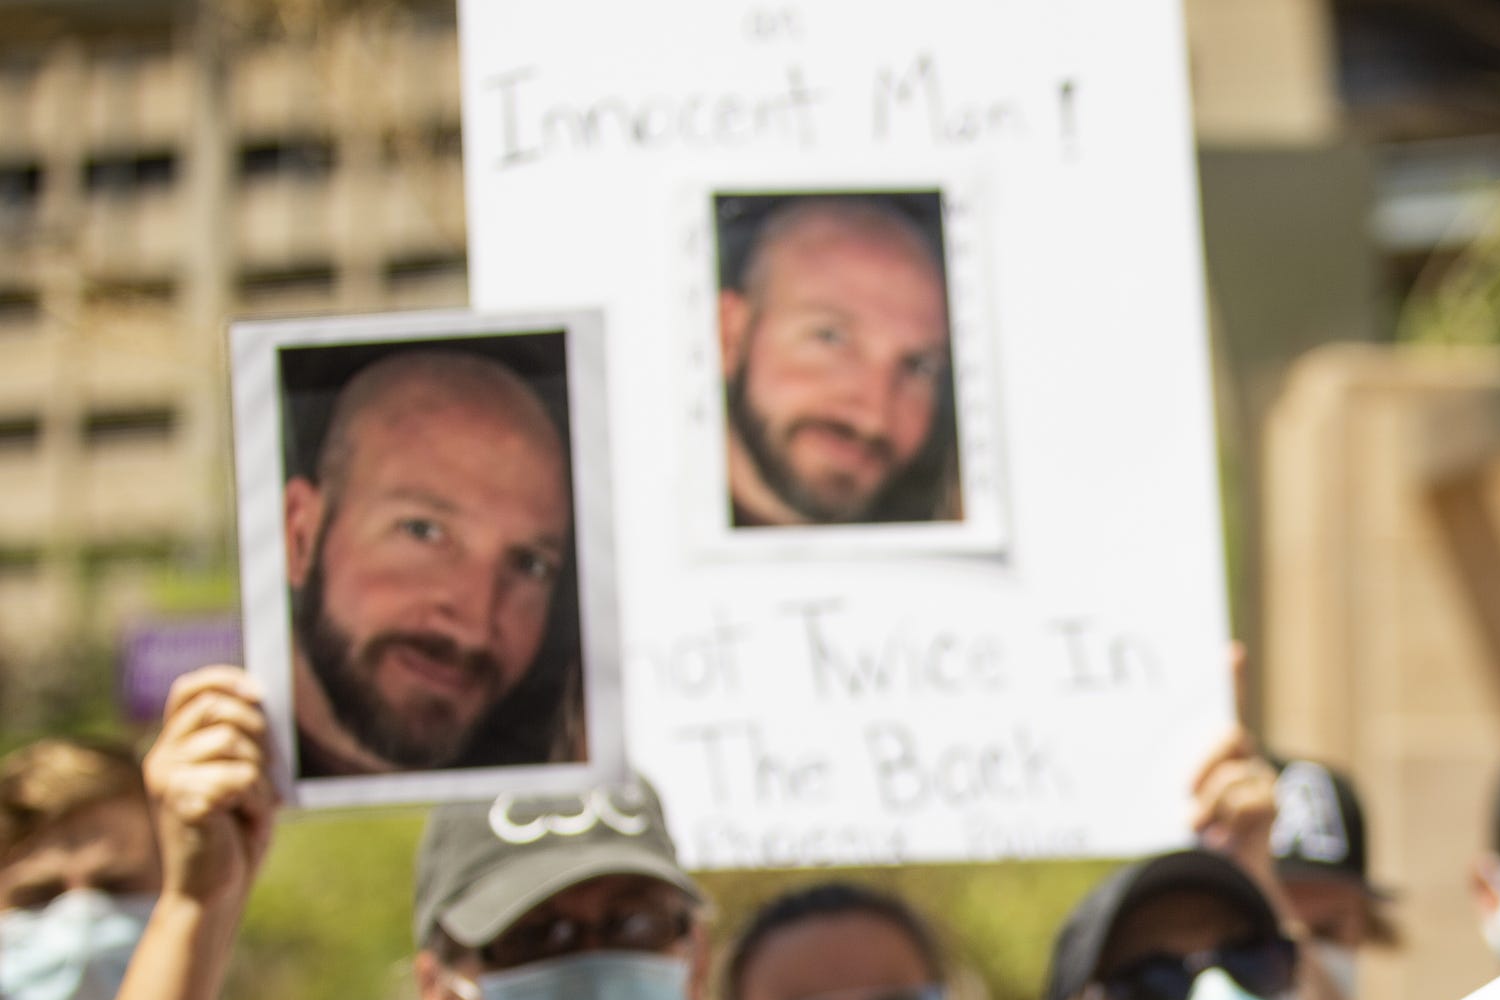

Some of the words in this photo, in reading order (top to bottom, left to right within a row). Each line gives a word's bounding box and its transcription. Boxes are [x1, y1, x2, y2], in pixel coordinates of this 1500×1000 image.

[484, 62, 829, 172] Innocent
[772, 593, 1012, 702] Twice
[1042, 610, 1167, 695] In
[667, 716, 835, 810] The
[862, 715, 1077, 815] Back
